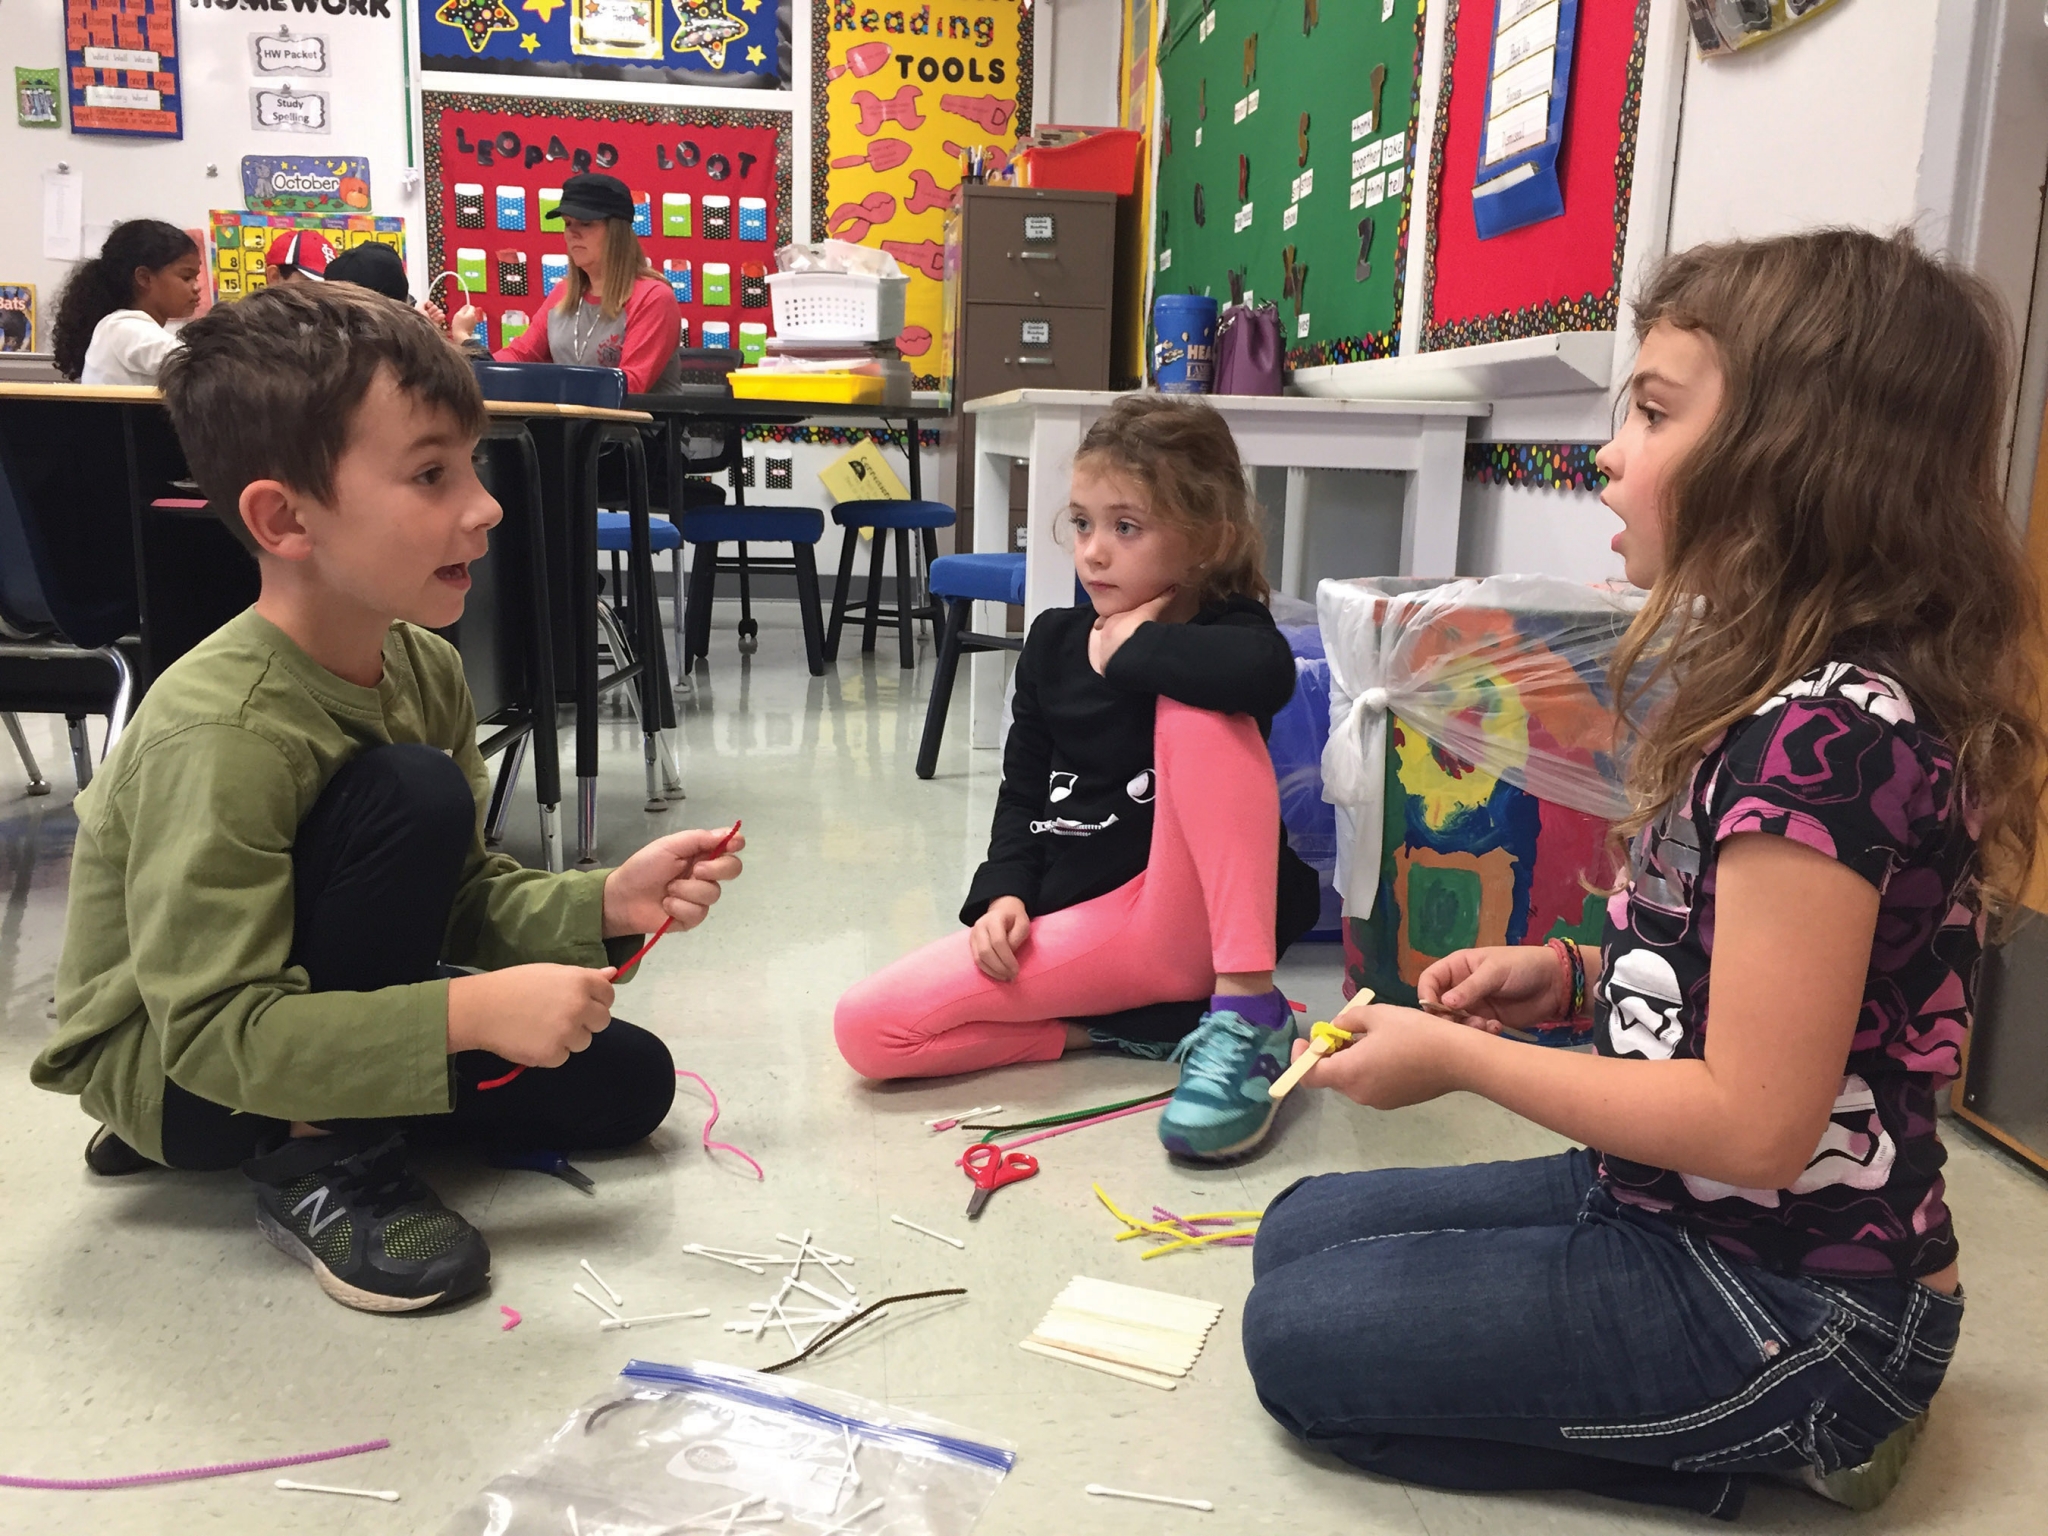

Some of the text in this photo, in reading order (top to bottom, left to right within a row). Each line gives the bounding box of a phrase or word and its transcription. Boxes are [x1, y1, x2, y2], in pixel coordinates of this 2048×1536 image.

[190, 0, 391, 18] WORK
[833, 0, 995, 48] Reading
[264, 49, 317, 59] HW Packet
[895, 54, 1006, 83] TOOLS
[277, 98, 304, 110] Study
[272, 112, 310, 124] Spelling
[456, 127, 758, 181] LEOPARD LOOT
[274, 173, 339, 190] October
[255, 235, 262, 246] 2
[230, 256, 264, 270] 8 9
[224, 279, 238, 290] 15
[291, 1185, 347, 1238] N
